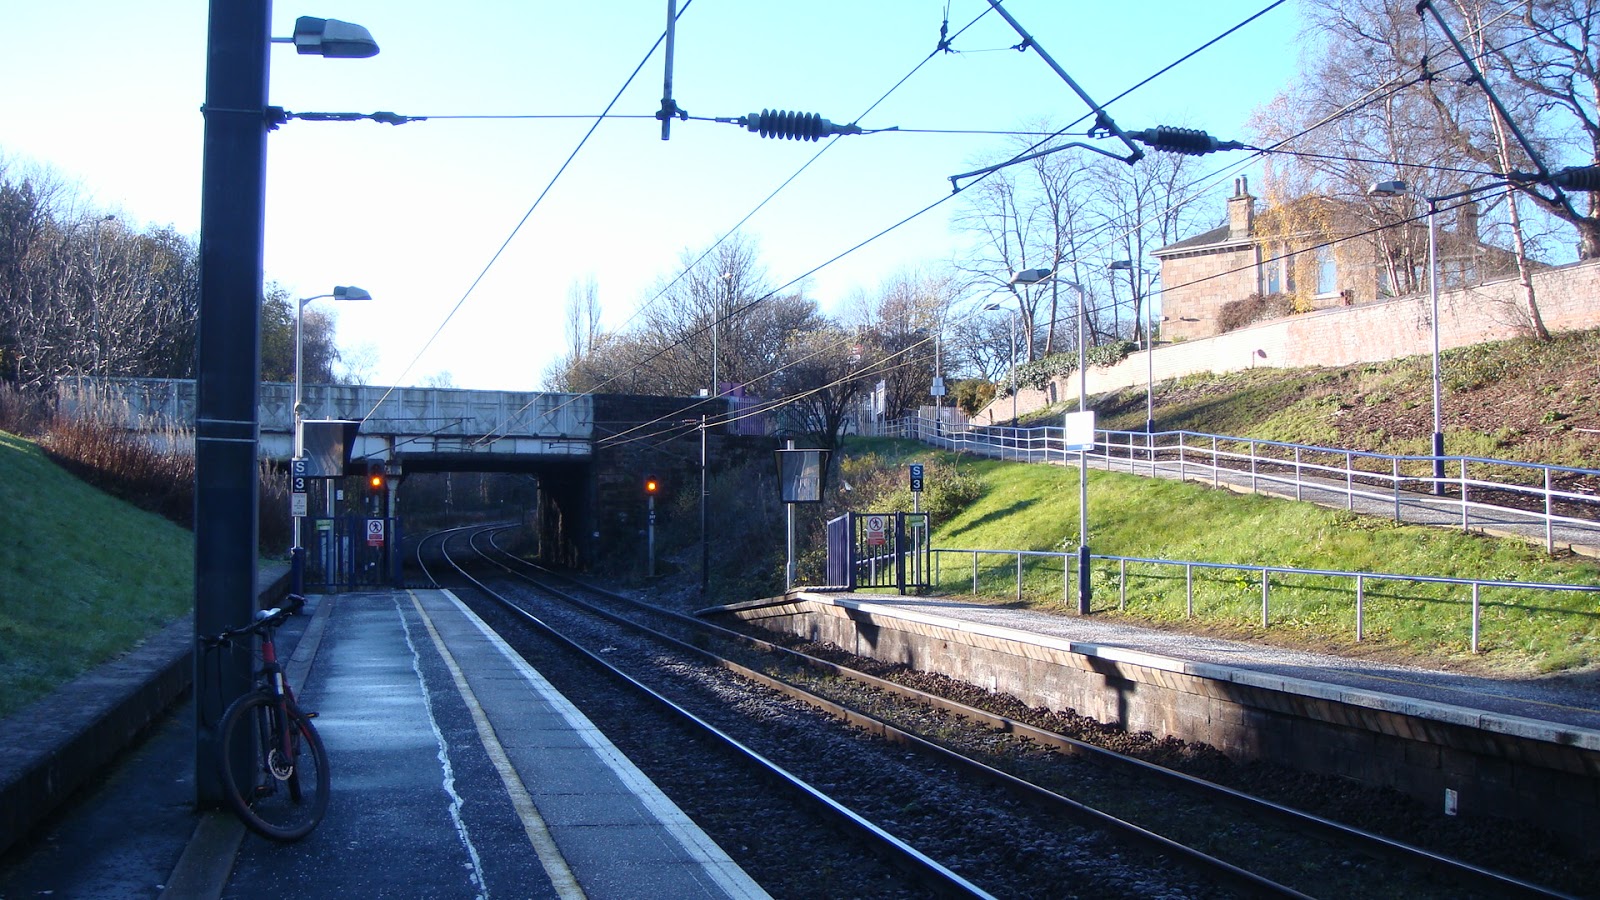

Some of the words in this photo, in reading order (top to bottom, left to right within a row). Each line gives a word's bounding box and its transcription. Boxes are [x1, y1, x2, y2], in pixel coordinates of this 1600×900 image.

[296, 461, 304, 472] S
[913, 466, 920, 475] S
[296, 478, 304, 488] 3
[913, 480, 920, 488] 3
